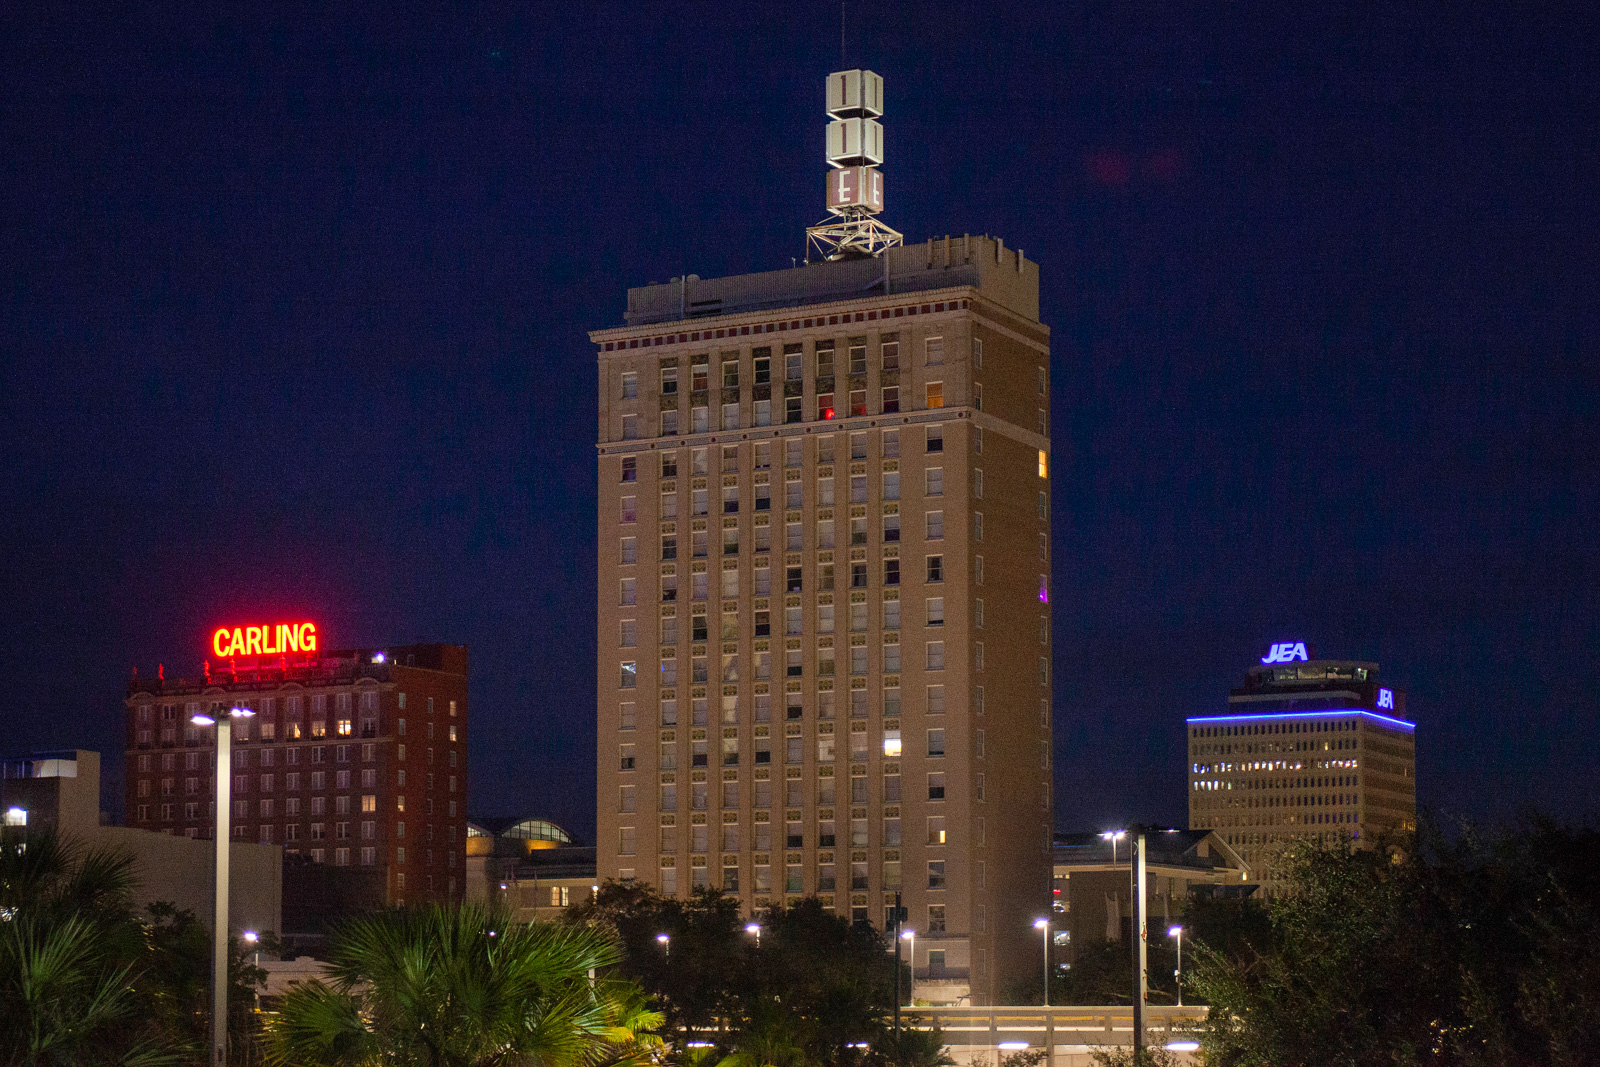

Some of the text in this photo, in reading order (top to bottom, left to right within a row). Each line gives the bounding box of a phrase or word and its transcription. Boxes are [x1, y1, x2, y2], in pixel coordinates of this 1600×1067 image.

[213, 622, 317, 657] CARLING
[1261, 642, 1309, 664] JEA
[1376, 688, 1394, 710] JEA
